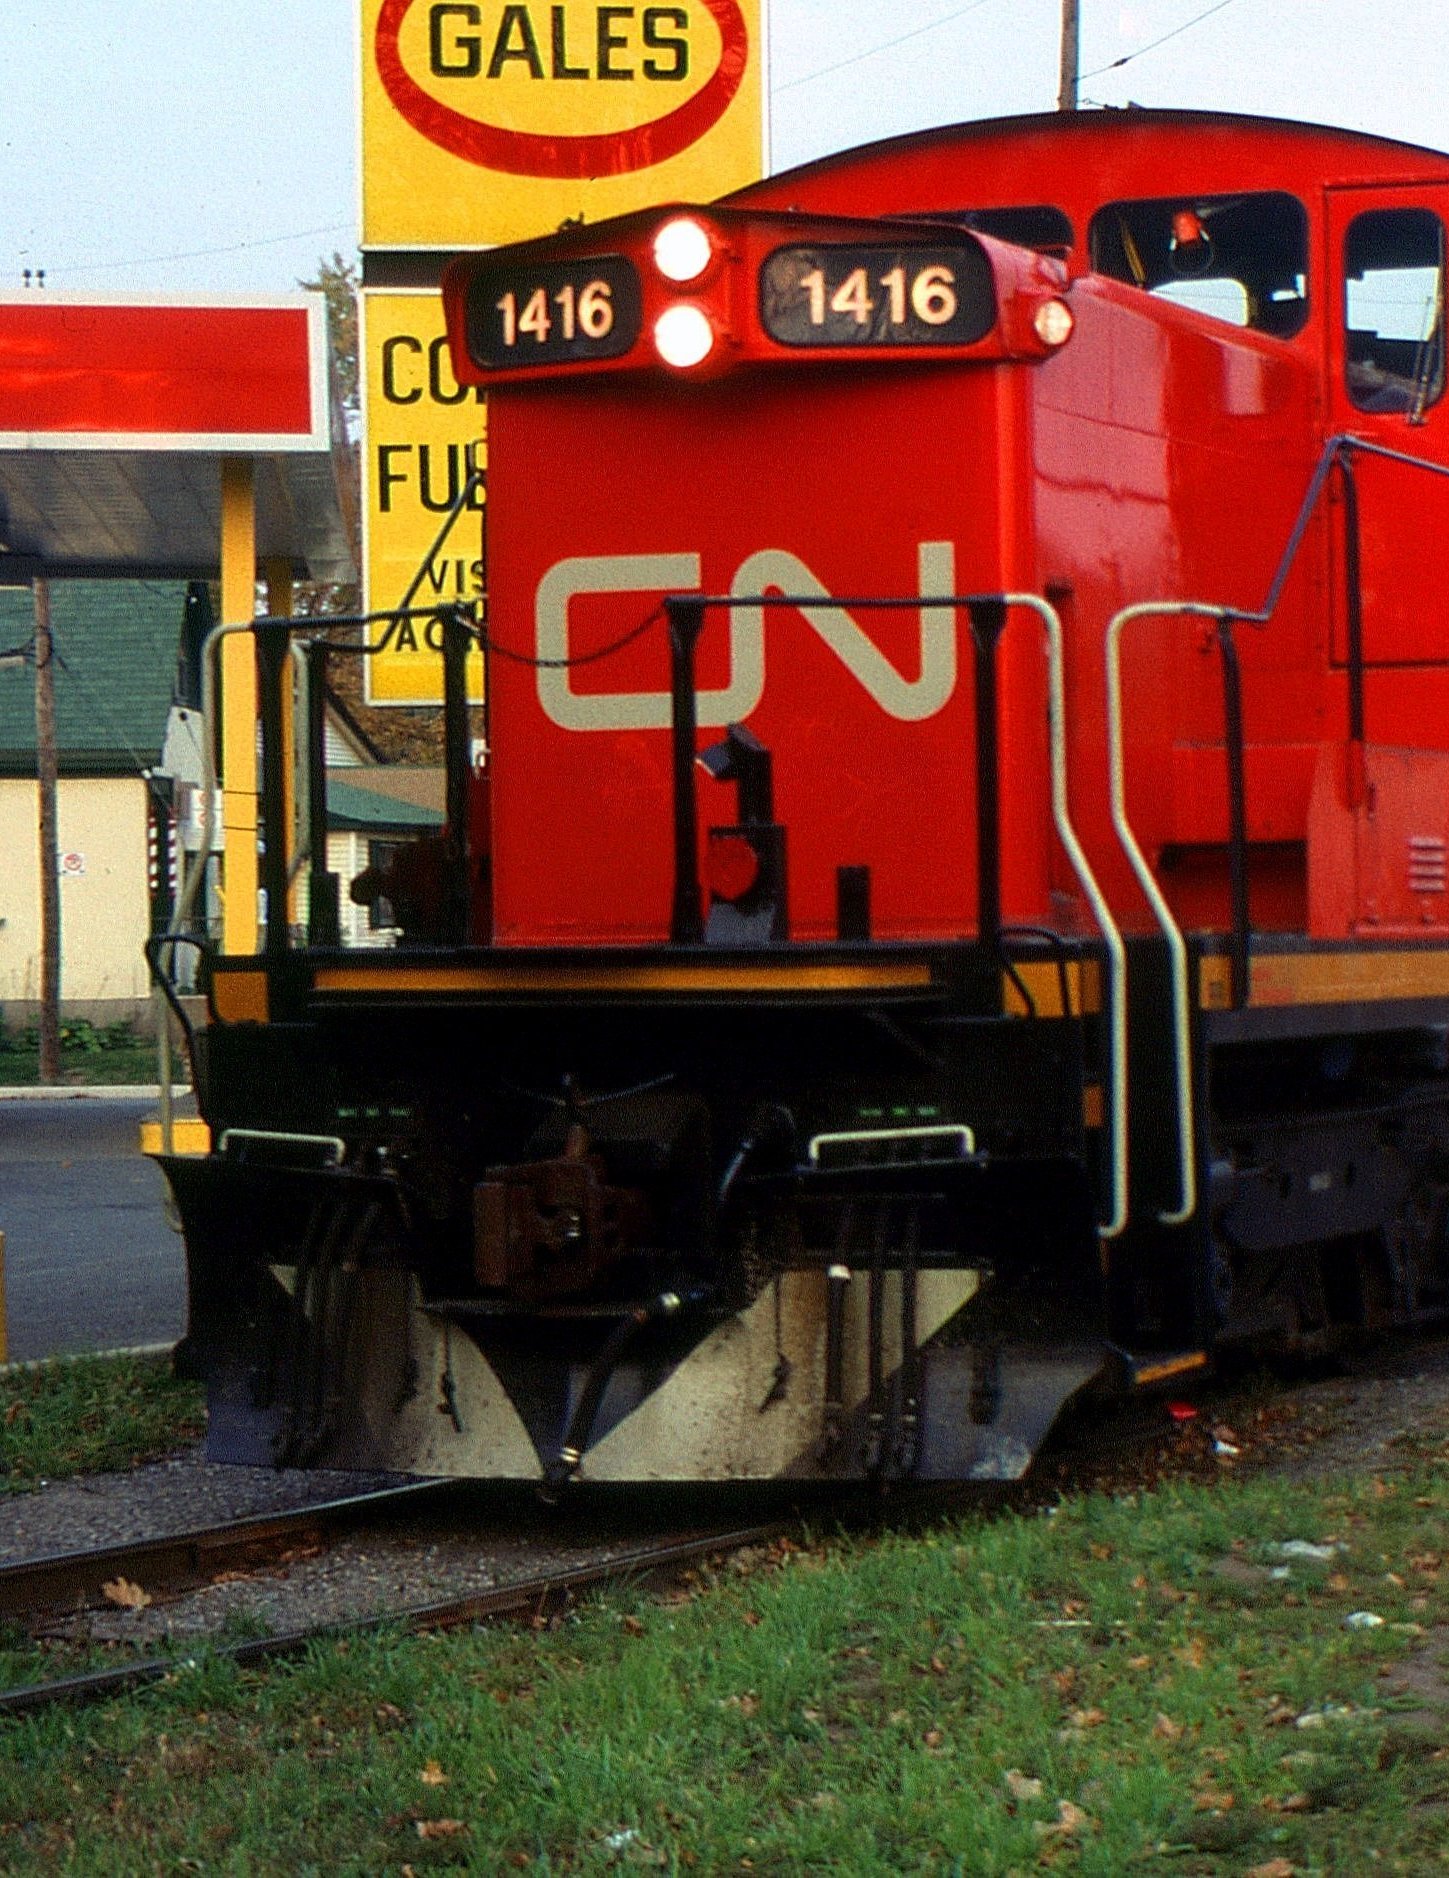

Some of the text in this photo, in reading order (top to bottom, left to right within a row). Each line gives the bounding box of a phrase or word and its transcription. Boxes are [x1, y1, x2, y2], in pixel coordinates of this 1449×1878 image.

[429, 3, 689, 81] GALES
[497, 280, 614, 347] 1416
[800, 265, 957, 326] 1416
[382, 336, 487, 406] CO
[535, 540, 957, 732] CN
